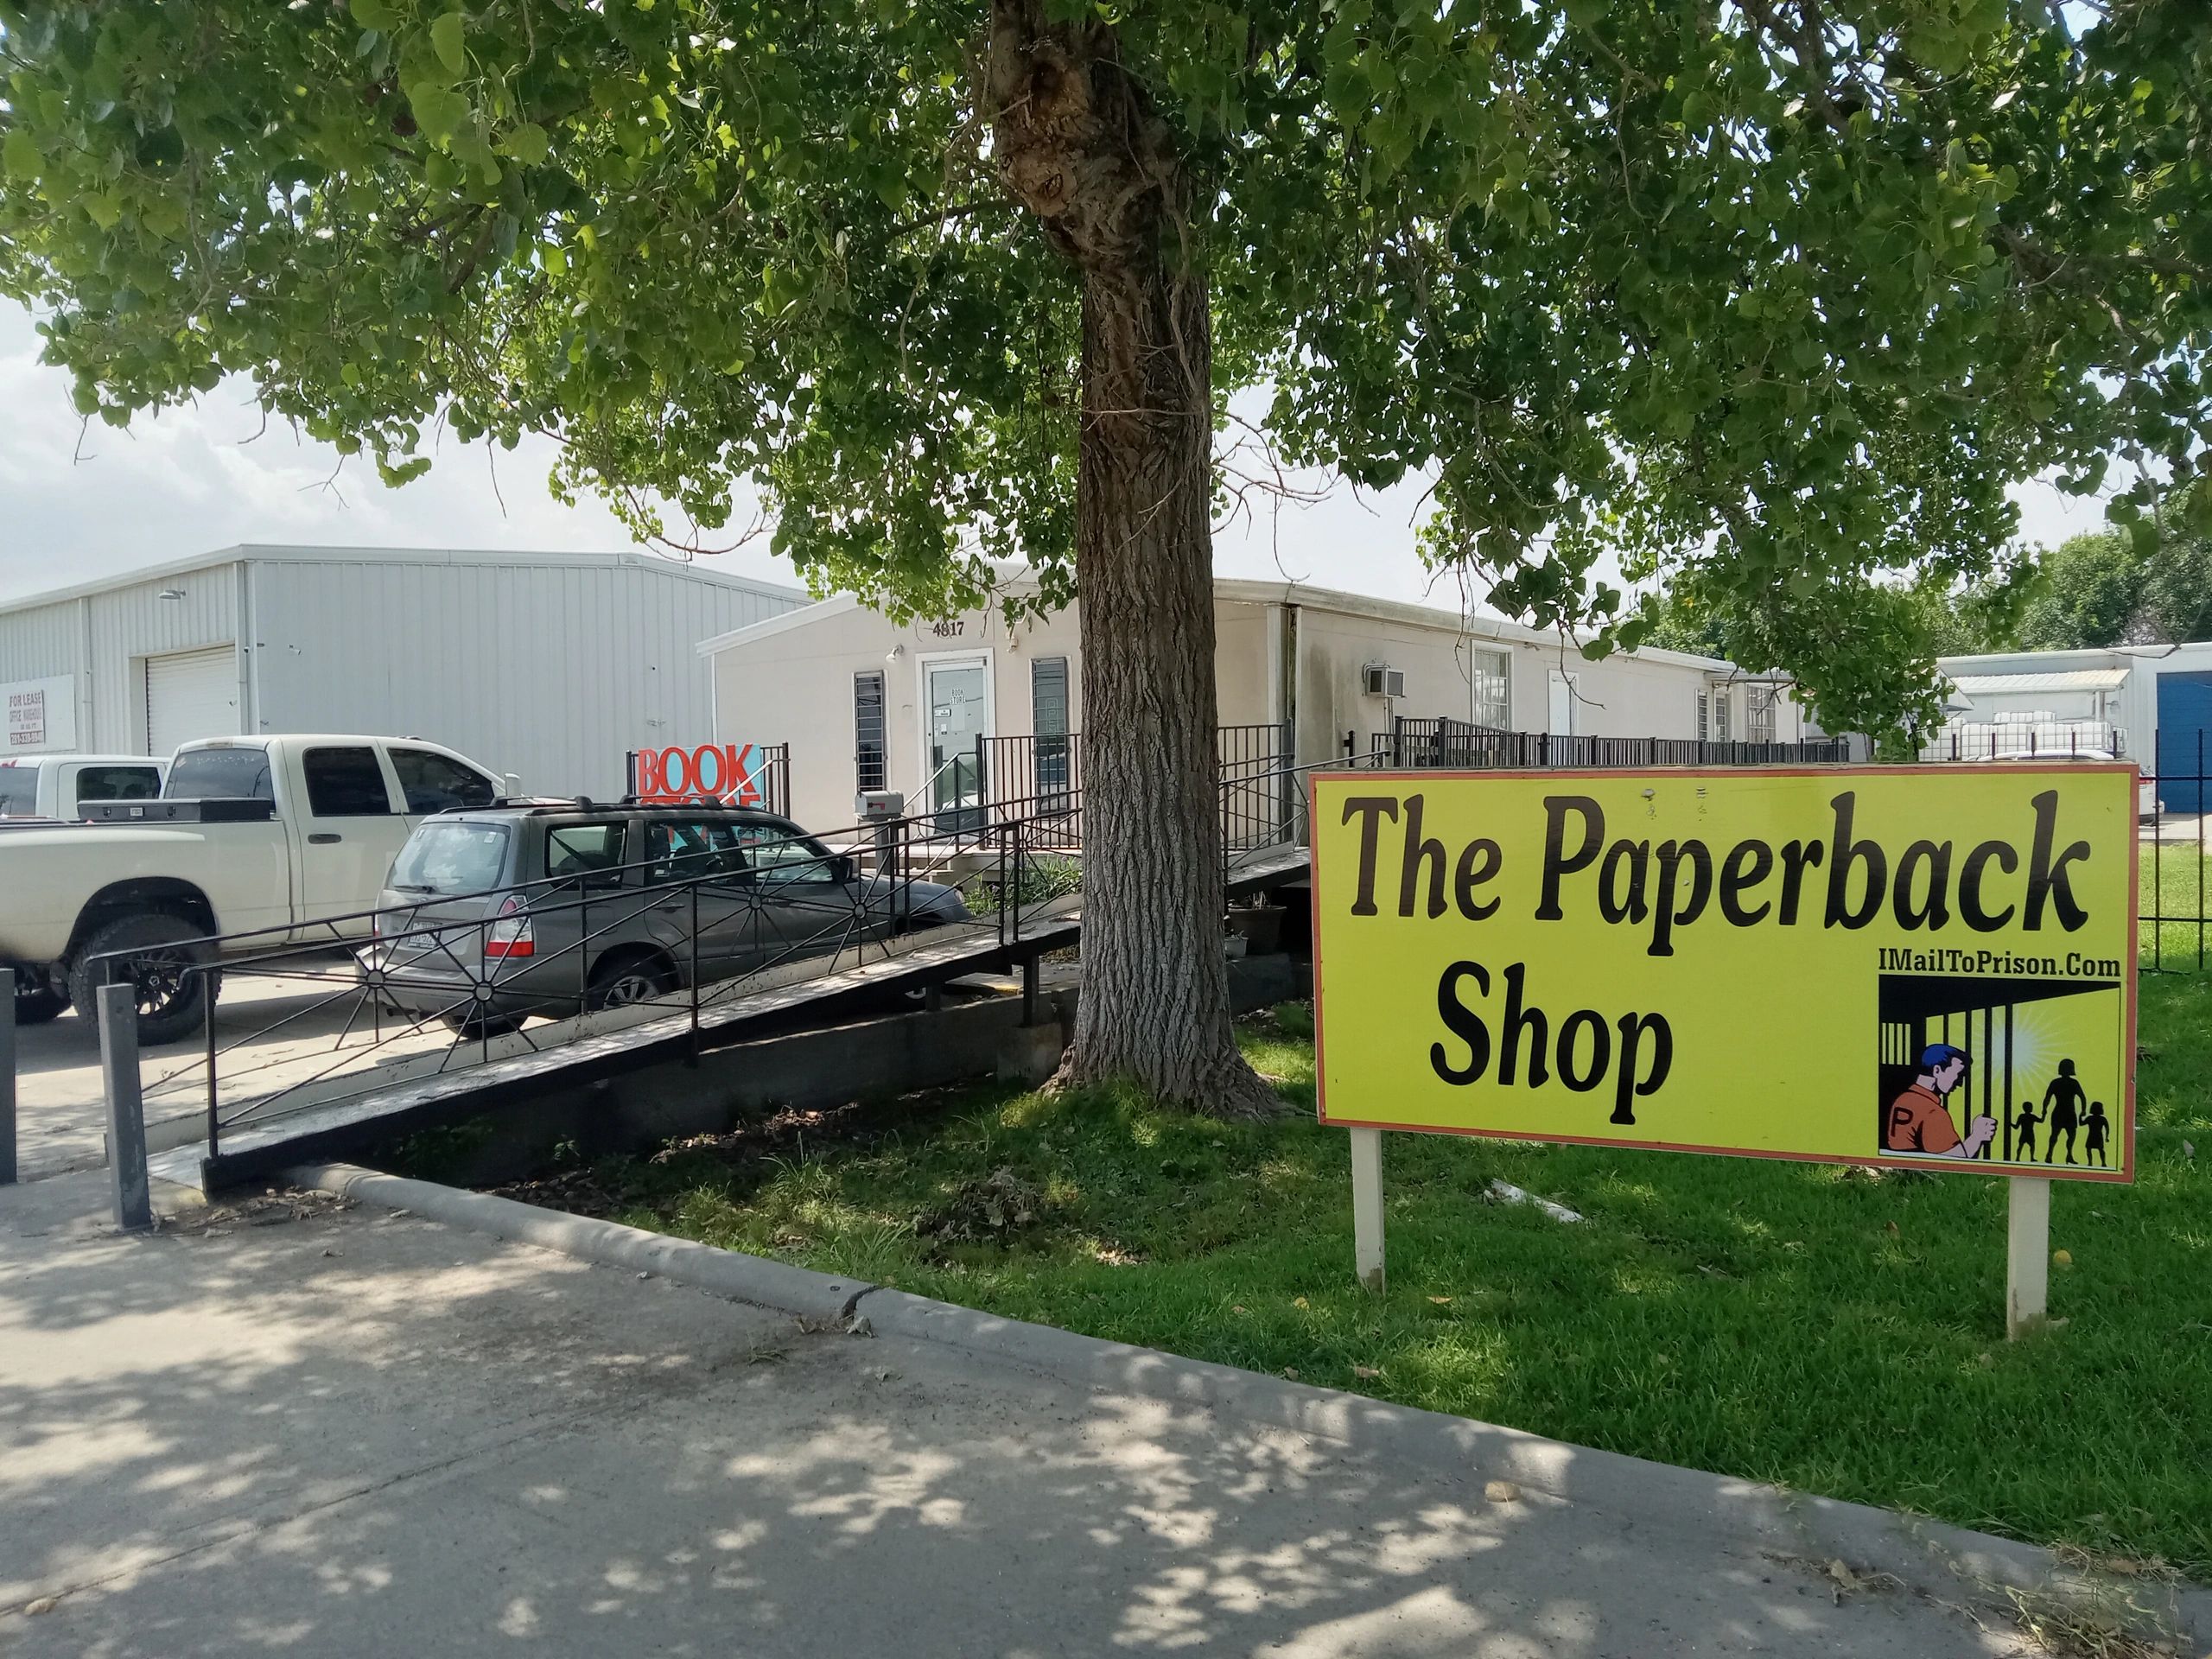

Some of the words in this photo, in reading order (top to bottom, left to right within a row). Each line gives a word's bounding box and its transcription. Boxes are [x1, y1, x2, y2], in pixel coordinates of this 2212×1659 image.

[933, 621, 964, 637] 4817
[10, 696, 22, 707] FOR
[23, 692, 41, 705] LEASE
[639, 744, 756, 796] BOOK
[1342, 794, 1502, 921] The
[1535, 790, 2089, 957] Paperback
[1878, 948, 2121, 977] IMailToPrison.Com
[1430, 961, 1673, 1125] Shop
[1890, 1107, 1913, 1137] P
